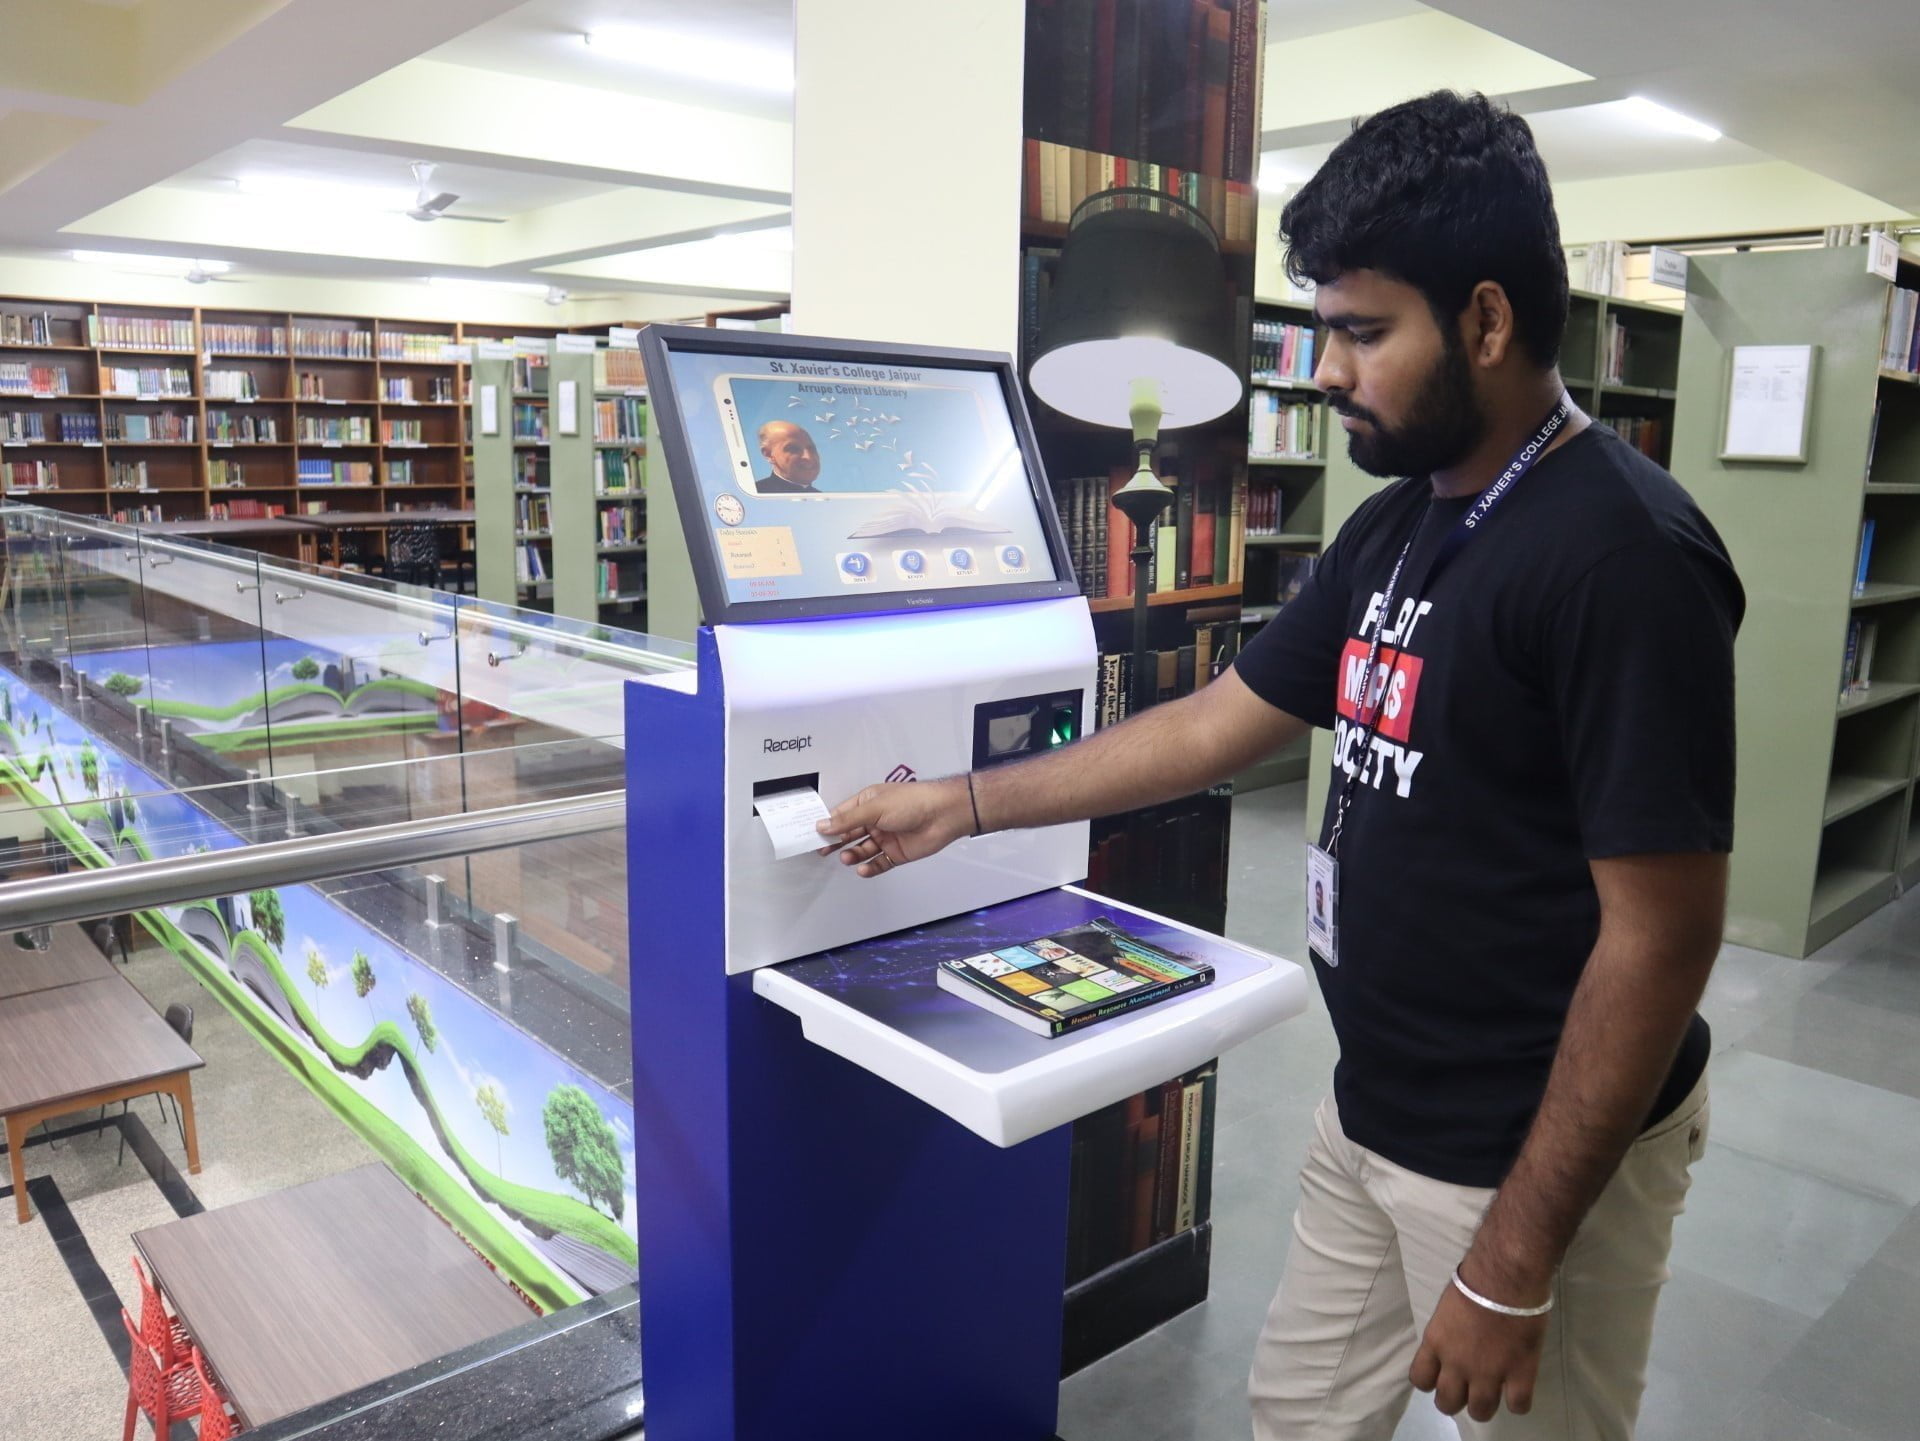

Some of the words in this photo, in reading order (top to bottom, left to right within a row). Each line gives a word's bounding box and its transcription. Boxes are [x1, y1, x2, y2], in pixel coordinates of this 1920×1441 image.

[770, 361, 788, 374] St.
[790, 362, 840, 377] Xavier's
[842, 366, 885, 381] College
[888, 369, 922, 382] Jaipur
[798, 383, 833, 396] Arrupe
[835, 384, 872, 396] Central
[874, 386, 908, 399] Library
[1465, 511, 1483, 529] ST.
[1478, 461, 1522, 512] XAVIER'S
[1520, 415, 1562, 462] COLLEGE
[1558, 404, 1570, 419] JA
[1367, 610, 1386, 666] COLLEGE
[1108, 683, 1117, 695] of
[1356, 667, 1372, 710] JAIPUR
[1107, 694, 1117, 710] the
[763, 735, 812, 753] Receipt
[1071, 1013, 1097, 1026] Human
[1098, 1001, 1127, 1016] Resource
[1129, 986, 1171, 1006] Management
